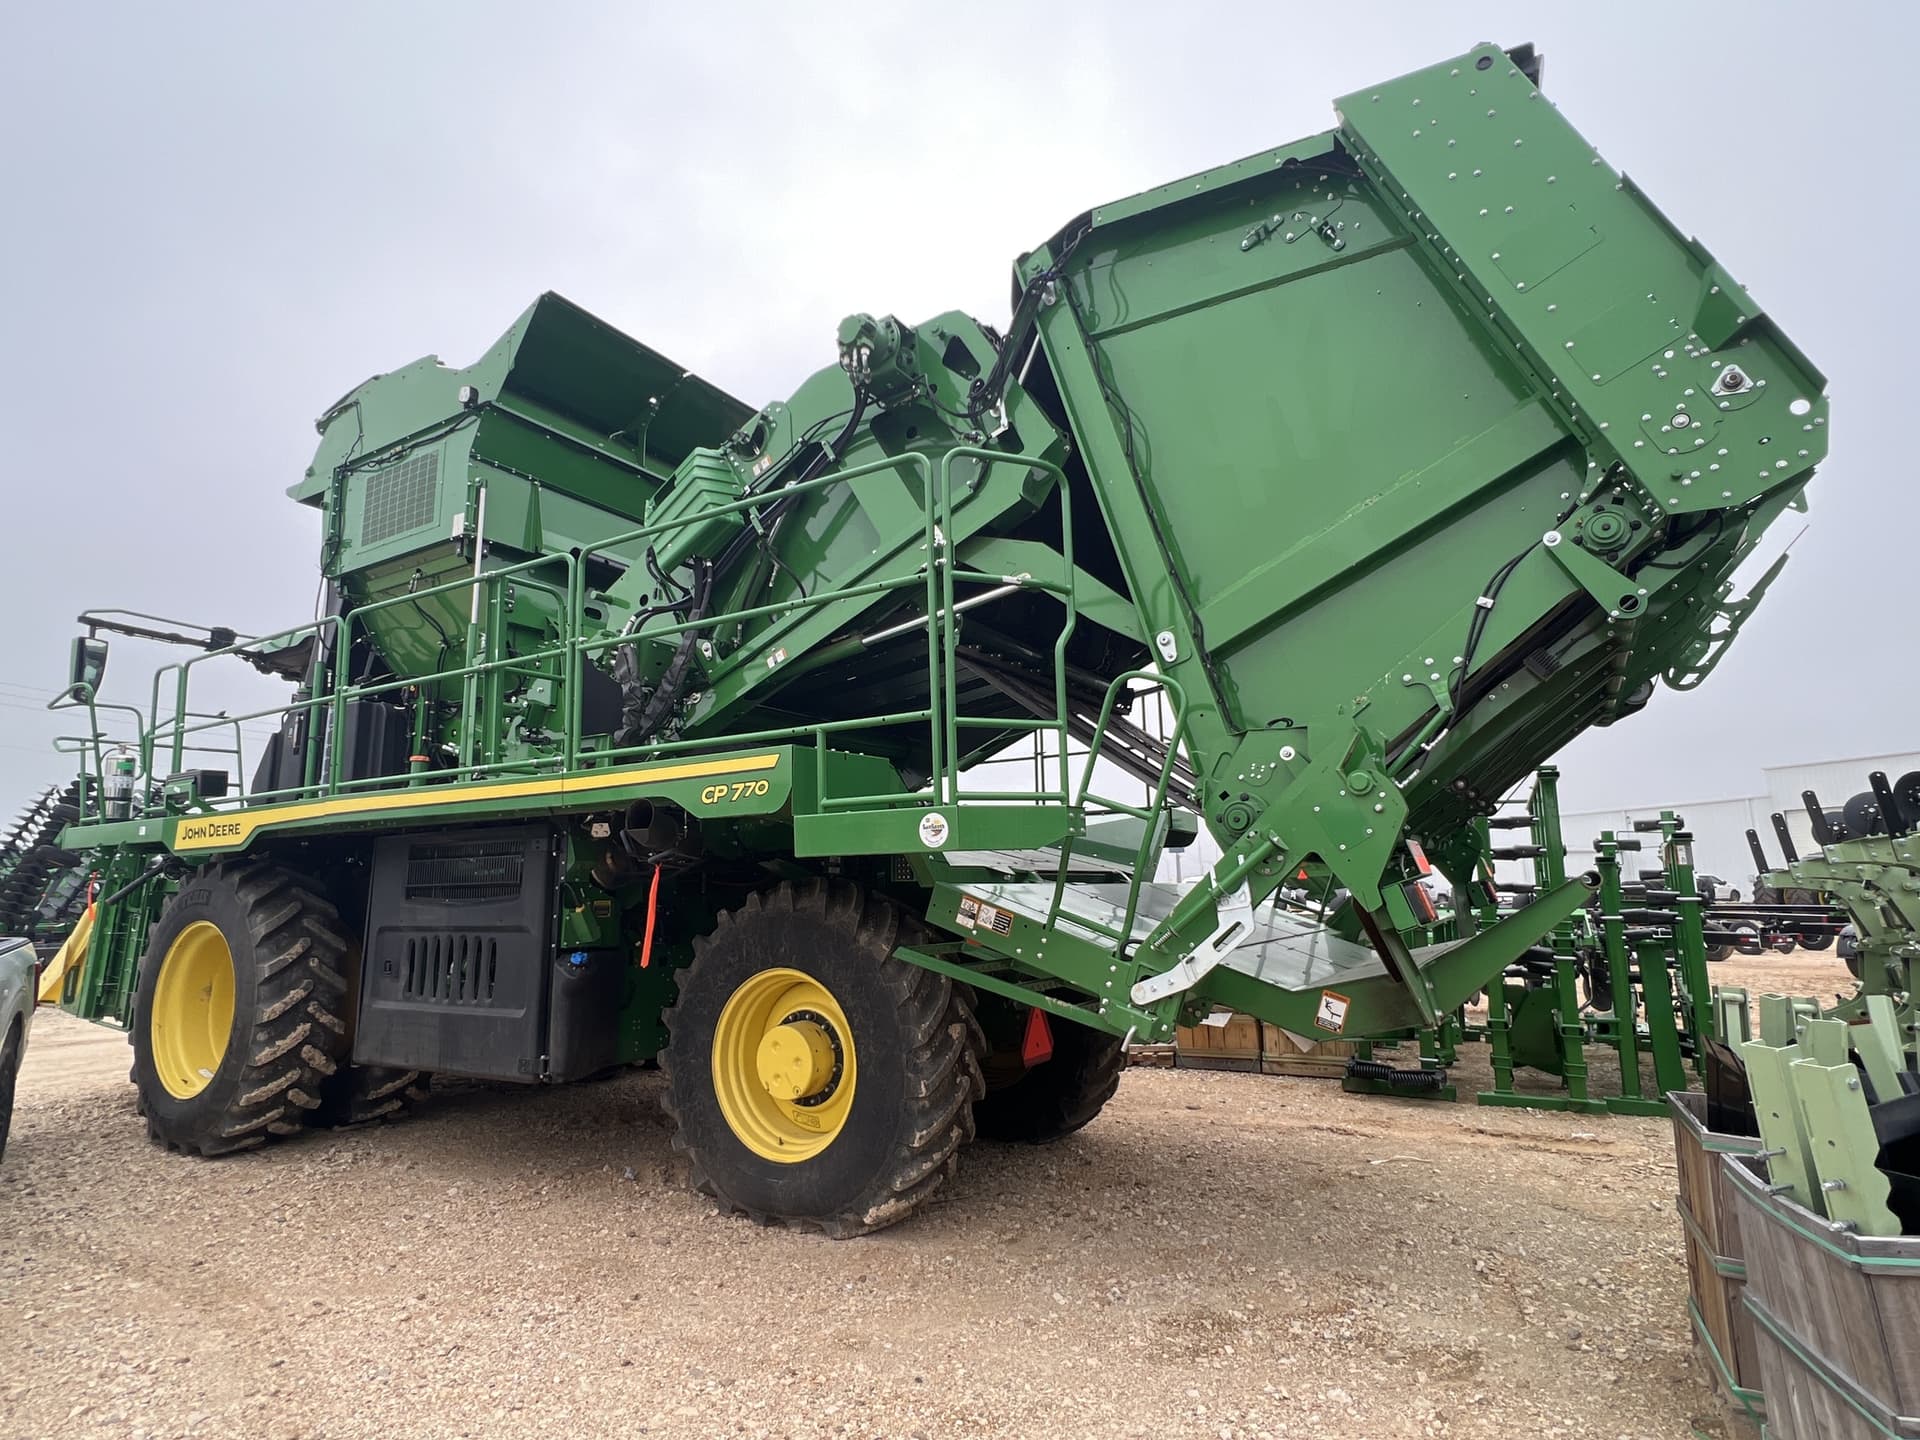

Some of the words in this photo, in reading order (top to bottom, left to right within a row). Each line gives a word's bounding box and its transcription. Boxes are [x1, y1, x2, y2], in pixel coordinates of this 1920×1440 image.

[701, 784, 729, 805] CP
[729, 779, 769, 803] 770
[182, 826, 207, 840] JOHN
[208, 823, 241, 838] DEERE
